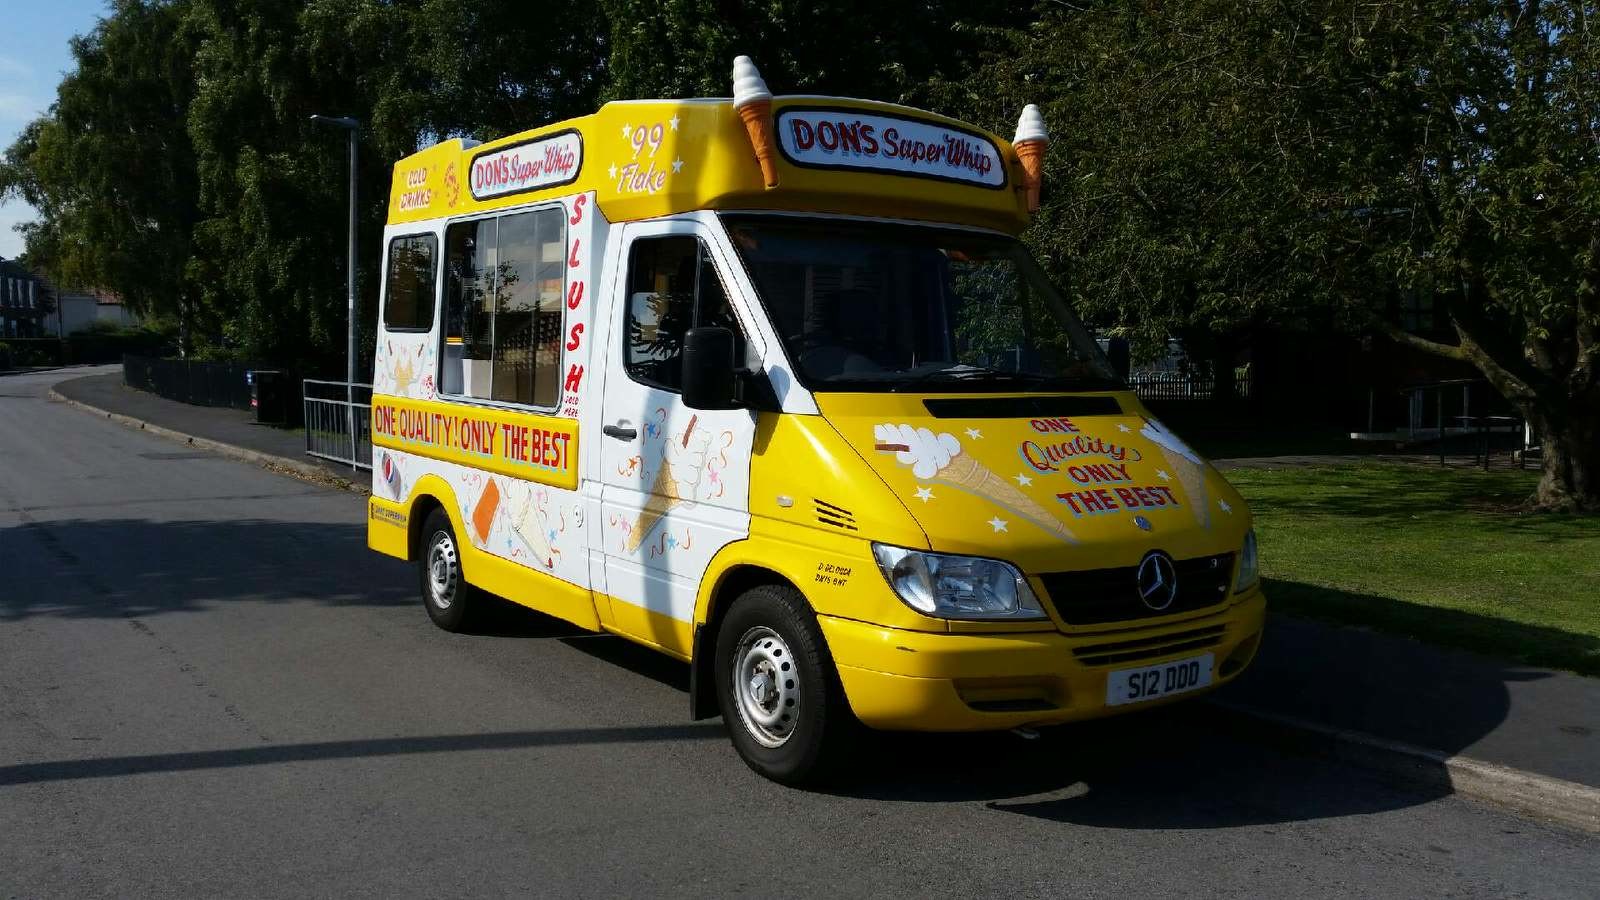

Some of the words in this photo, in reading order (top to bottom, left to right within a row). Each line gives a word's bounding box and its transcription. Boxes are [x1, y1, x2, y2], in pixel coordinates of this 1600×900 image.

[630, 122, 664, 158] 99
[793, 118, 878, 154] DON'S
[884, 128, 946, 163] Super
[944, 135, 992, 174] Whip
[407, 166, 427, 187] COLD
[509, 152, 544, 185] Super
[544, 143, 575, 175] Whip
[617, 159, 666, 193] Flake
[400, 187, 432, 211] DRINKS
[374, 404, 396, 436] ONE
[460, 420, 498, 456] ONLY
[502, 422, 529, 461] THE
[531, 428, 571, 470] BEST
[1030, 417, 1080, 433] ONE
[1021, 434, 1142, 472] Quality
[1067, 463, 1132, 484] ONLY
[1056, 488, 1120, 516] THE
[1114, 486, 1180, 509] BEST
[1128, 670, 1161, 699] S12
[1164, 661, 1200, 692] DDD
